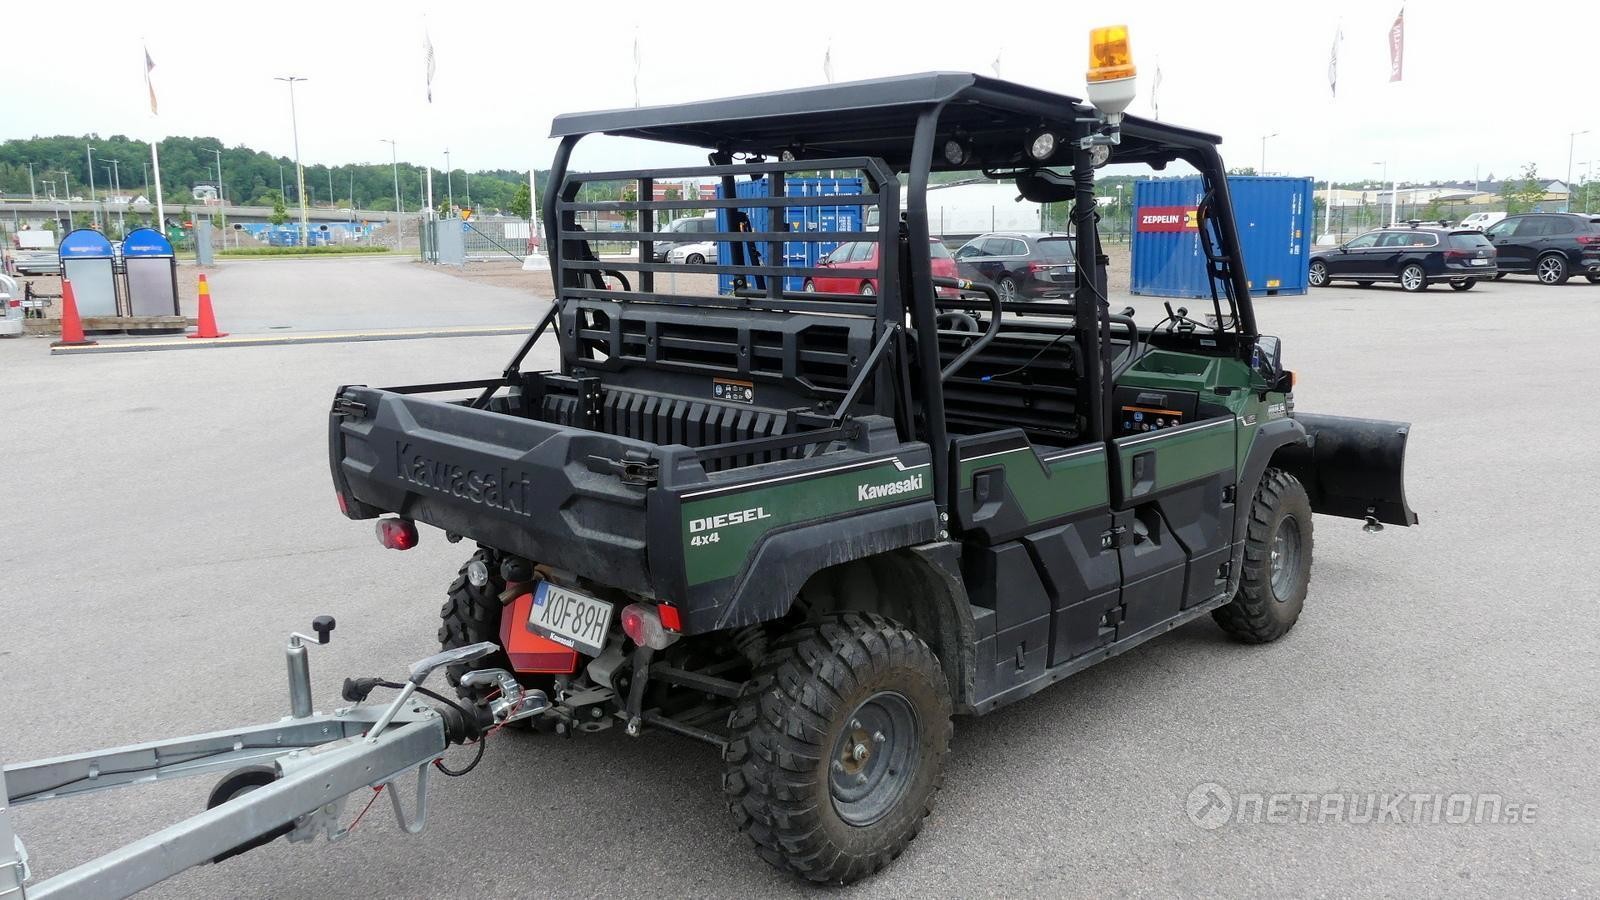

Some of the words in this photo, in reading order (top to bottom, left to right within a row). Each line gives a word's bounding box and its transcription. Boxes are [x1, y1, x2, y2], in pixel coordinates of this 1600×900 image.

[1142, 215, 1179, 224] ZEPPELIN
[395, 440, 532, 518] Kawasaki
[857, 473, 923, 502] Kawasaki
[689, 507, 771, 533] DIESEL
[690, 532, 720, 547] 4x4
[541, 590, 608, 643] XOF89H
[549, 632, 575, 647] Kawasaki
